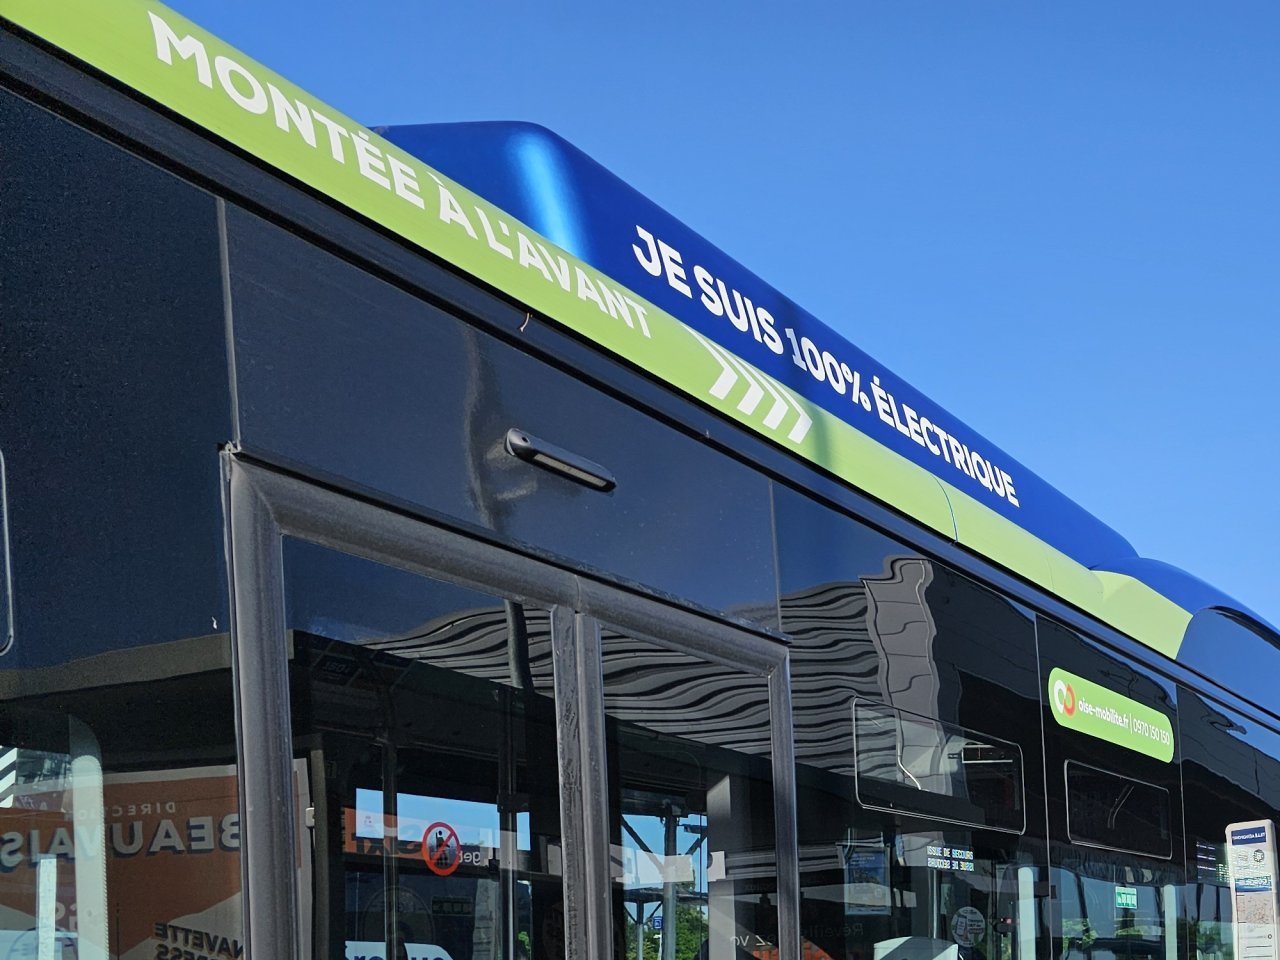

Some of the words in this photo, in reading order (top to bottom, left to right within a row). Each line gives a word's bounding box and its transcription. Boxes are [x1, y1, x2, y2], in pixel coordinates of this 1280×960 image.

[147, 10, 426, 210] MONTÉE
[433, 170, 478, 241] À
[475, 207, 652, 338] L'AVANT
[631, 224, 693, 298] JE
[693, 265, 784, 355] SUIS
[784, 327, 872, 413] 100%
[871, 375, 1020, 508] ÉLECTRIQUE
